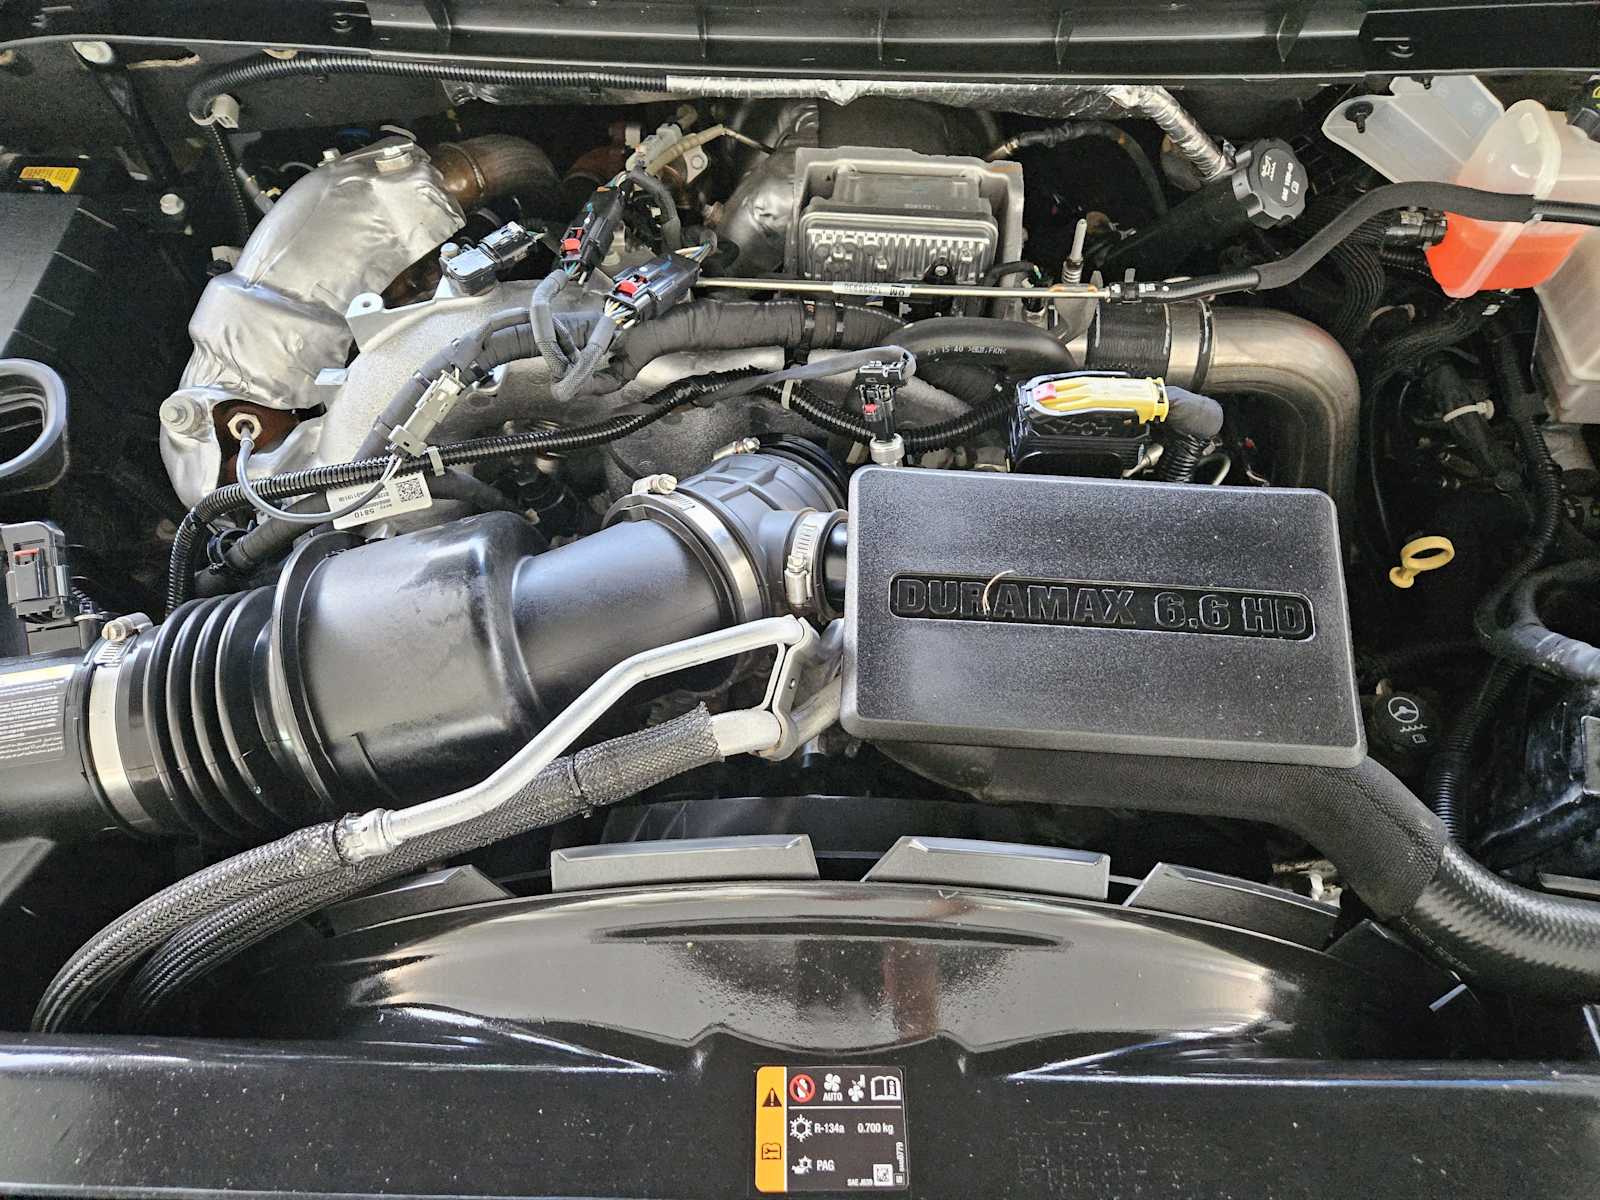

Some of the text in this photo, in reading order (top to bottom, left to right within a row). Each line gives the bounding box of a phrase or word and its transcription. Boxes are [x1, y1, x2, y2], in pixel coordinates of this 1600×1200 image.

[896, 578, 1306, 635] DURAMAX 6.6 HD
[822, 1091, 843, 1102] AUTO
[814, 1122, 894, 1136] R-134a 0.700 kg
[816, 1159, 836, 1172] PAG
